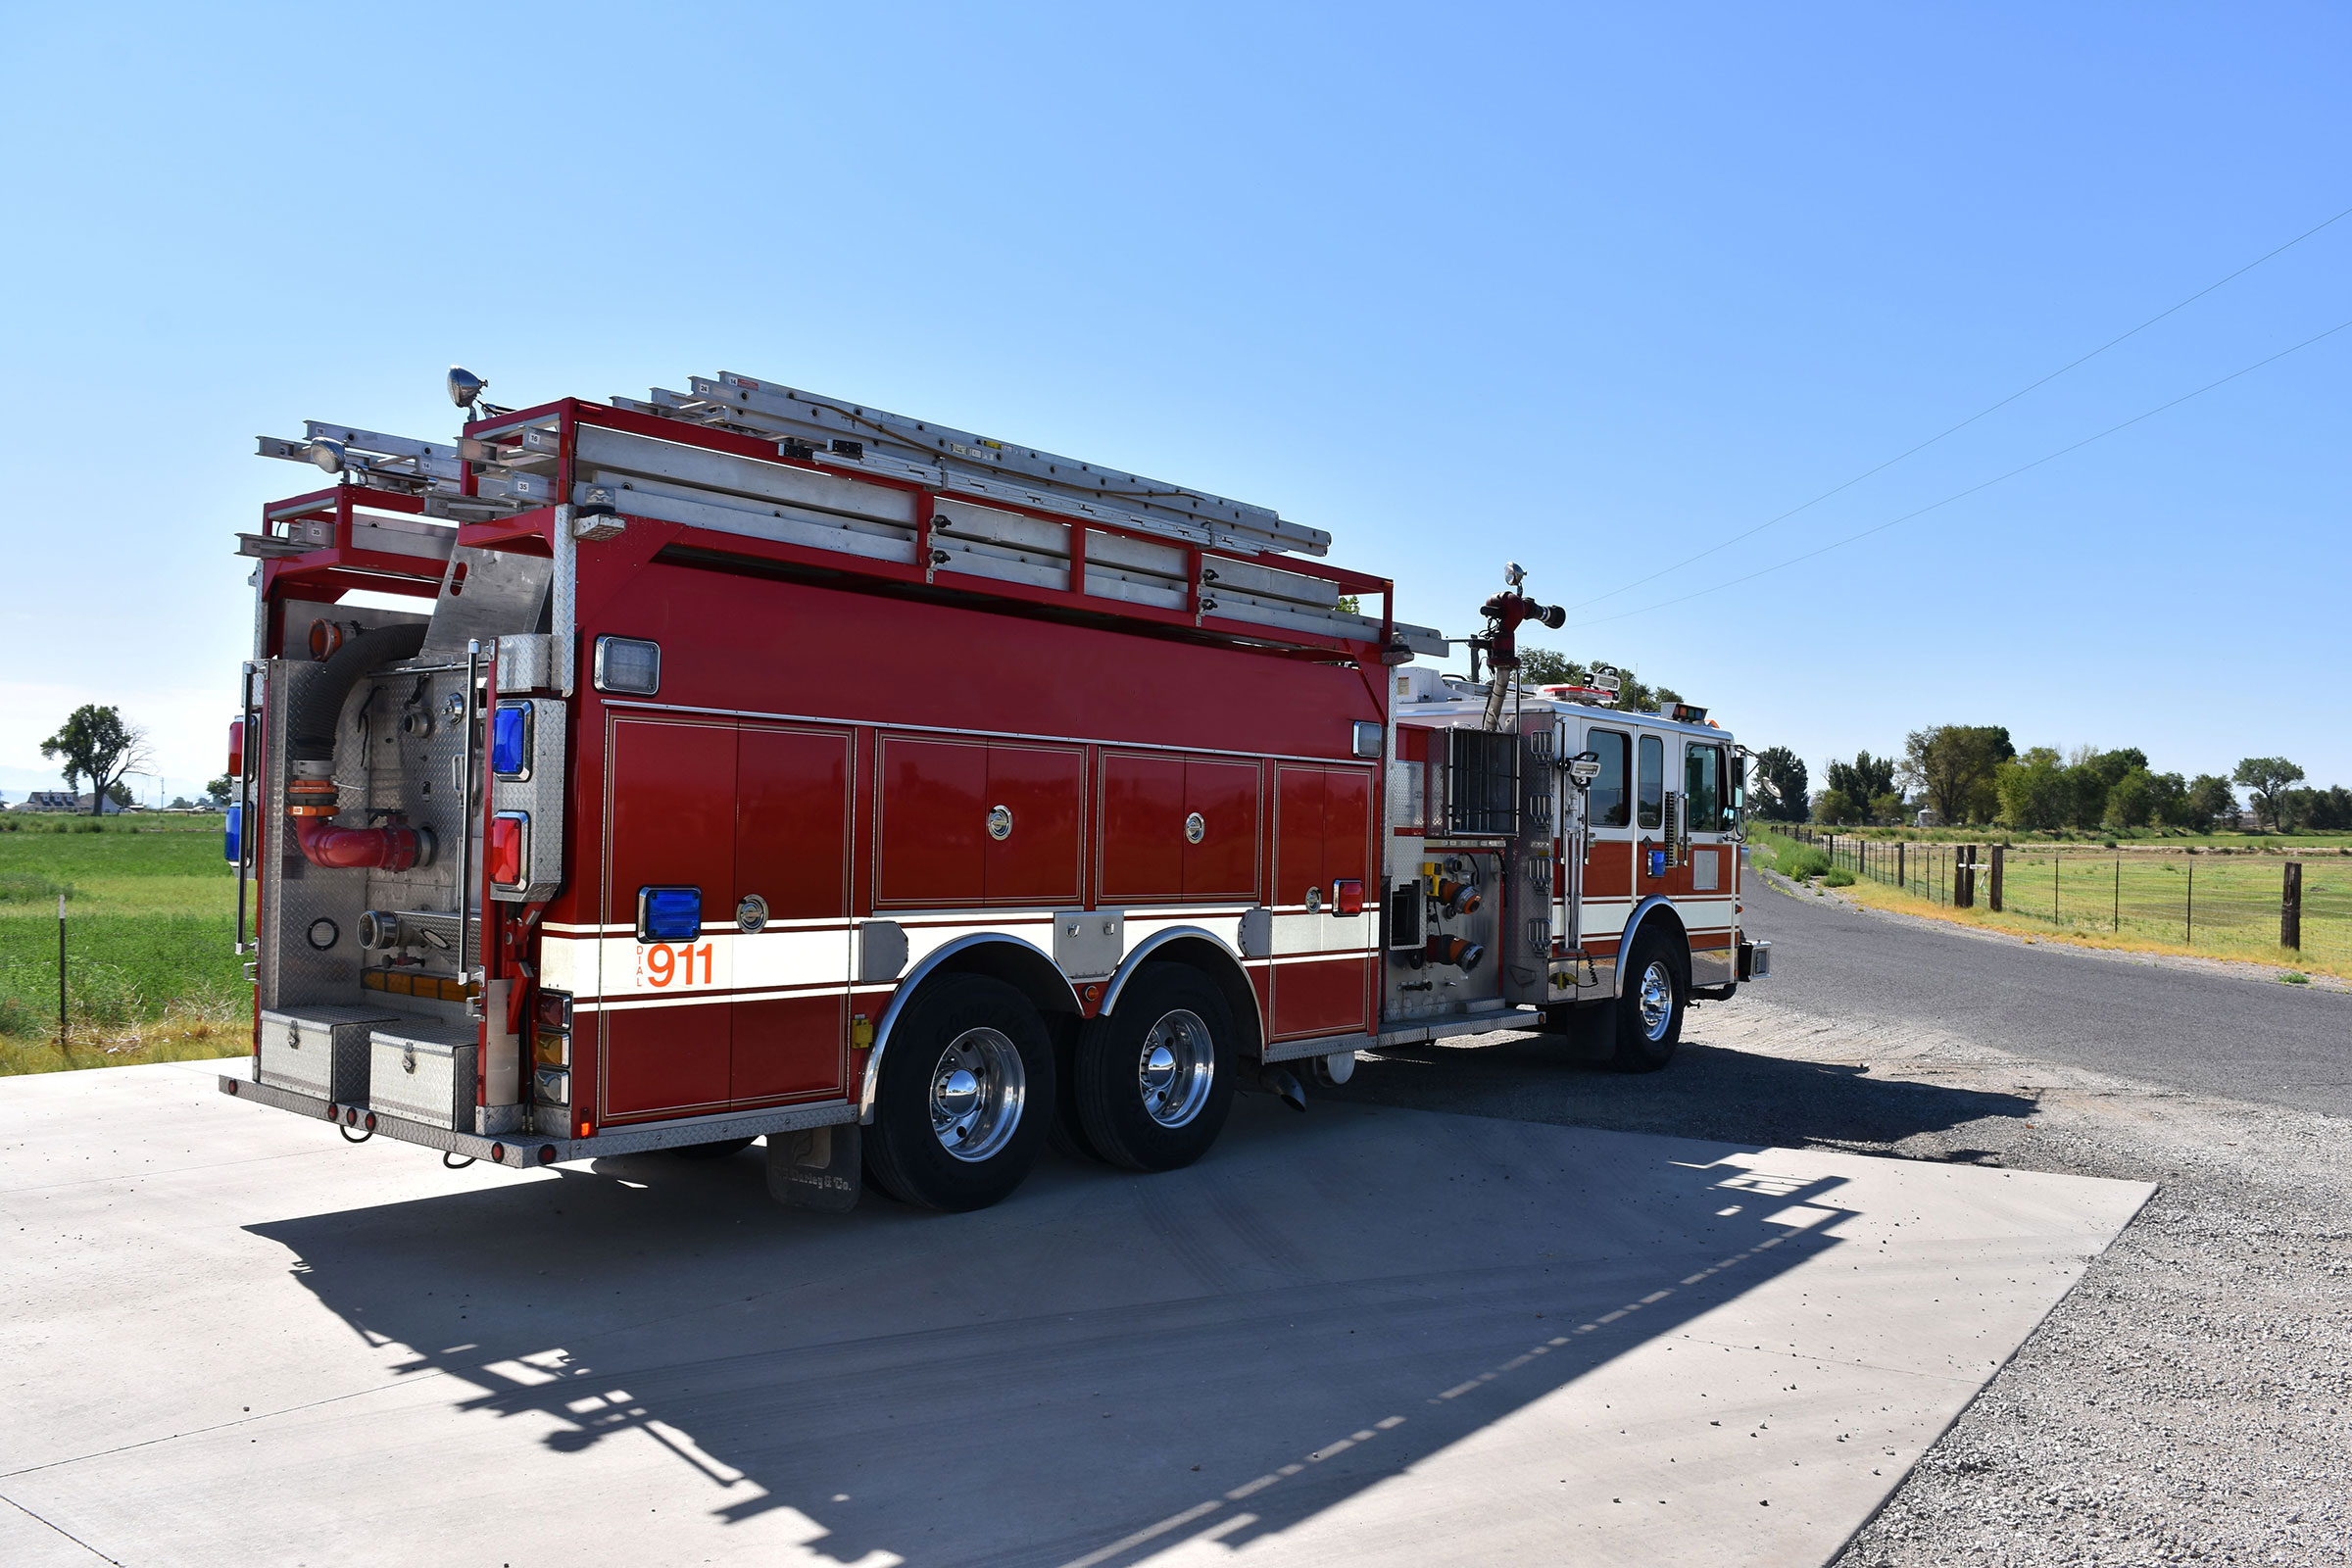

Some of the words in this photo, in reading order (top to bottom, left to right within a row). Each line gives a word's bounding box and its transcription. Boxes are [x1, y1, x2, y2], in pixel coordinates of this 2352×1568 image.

[530, 434, 538, 443] 16
[518, 482, 527, 491] 35
[647, 943, 712, 988] 911
[823, 1174, 832, 1189] &
[833, 1176, 852, 1192] Co.
